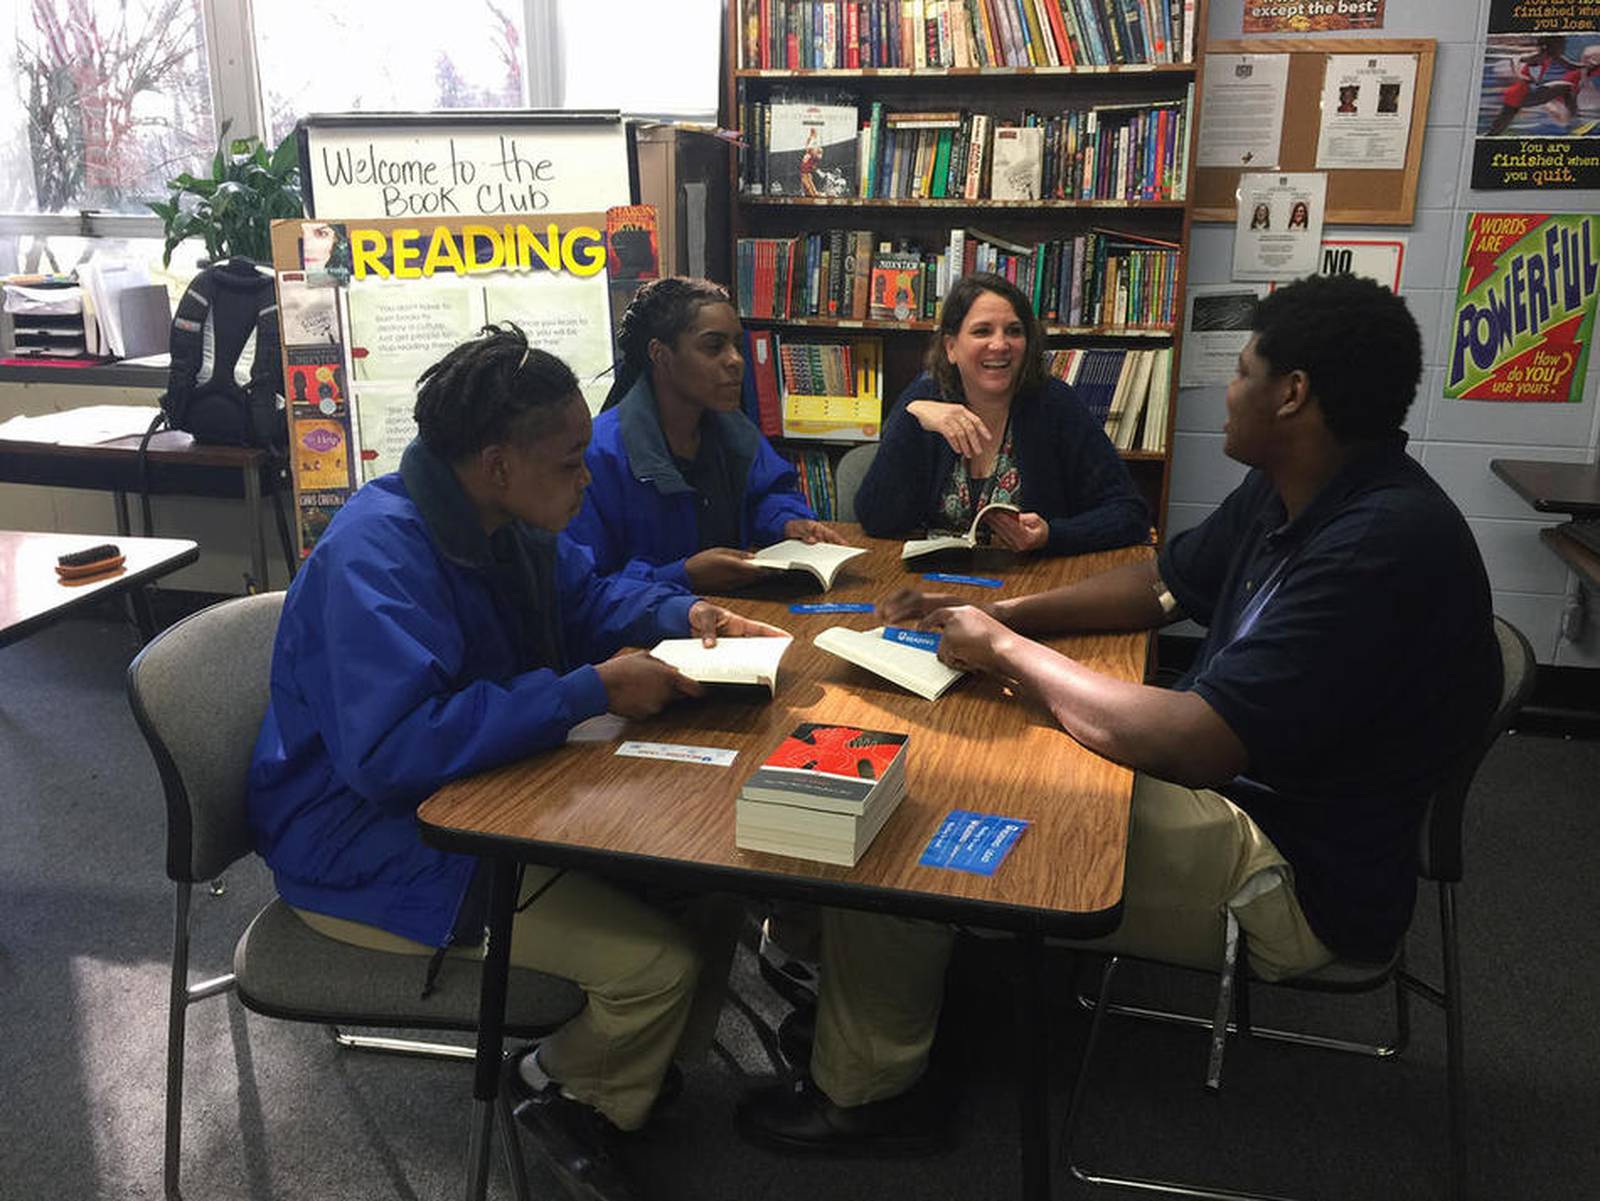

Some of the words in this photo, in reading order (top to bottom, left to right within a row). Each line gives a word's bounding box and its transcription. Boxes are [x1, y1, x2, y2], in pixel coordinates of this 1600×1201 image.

[1252, 4, 1305, 18] except
[1308, 2, 1335, 15] the
[1338, 0, 1378, 14] best.
[1513, 6, 1575, 17] finished
[1534, 19, 1559, 30] you
[1562, 18, 1597, 29] lose.
[1519, 141, 1544, 153] You
[1547, 143, 1571, 153] are
[322, 143, 439, 187] Welcome
[446, 138, 477, 186] to
[490, 135, 555, 183] the
[1491, 153, 1565, 167] finished
[1567, 155, 1600, 166] when
[1503, 170, 1528, 183] you
[1532, 167, 1576, 185] quit.
[476, 183, 550, 214] Club
[1480, 217, 1529, 236] WORDS
[349, 224, 606, 281] READING
[1475, 236, 1503, 253] ARE
[1322, 249, 1353, 274] NO
[1450, 218, 1598, 388] POWERFUL
[1532, 350, 1560, 366] How
[1507, 366, 1523, 381] do
[1525, 365, 1555, 382] YOU
[1492, 382, 1511, 393] use
